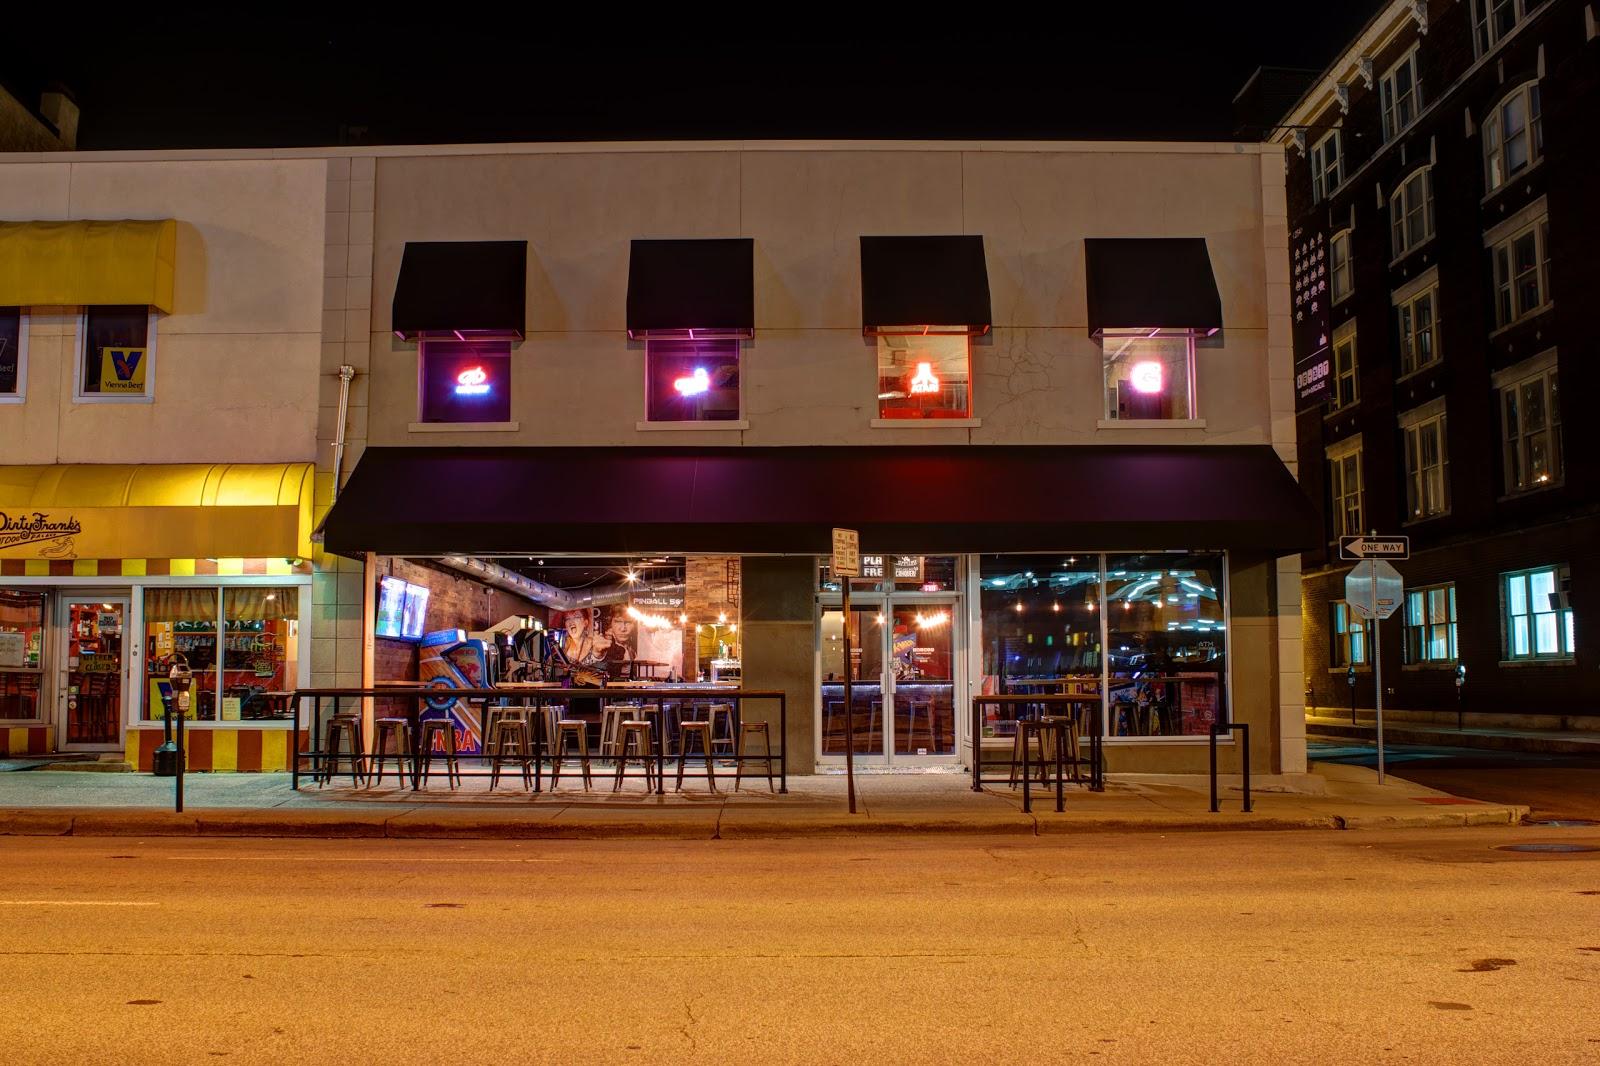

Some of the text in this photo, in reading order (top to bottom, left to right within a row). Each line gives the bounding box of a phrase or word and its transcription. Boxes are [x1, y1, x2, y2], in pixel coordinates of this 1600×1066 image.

[128, 381, 143, 390] Beef
[1361, 543, 1402, 552] ONE WAY
[863, 567, 883, 577] FRE
[633, 597, 667, 605] PINBALL
